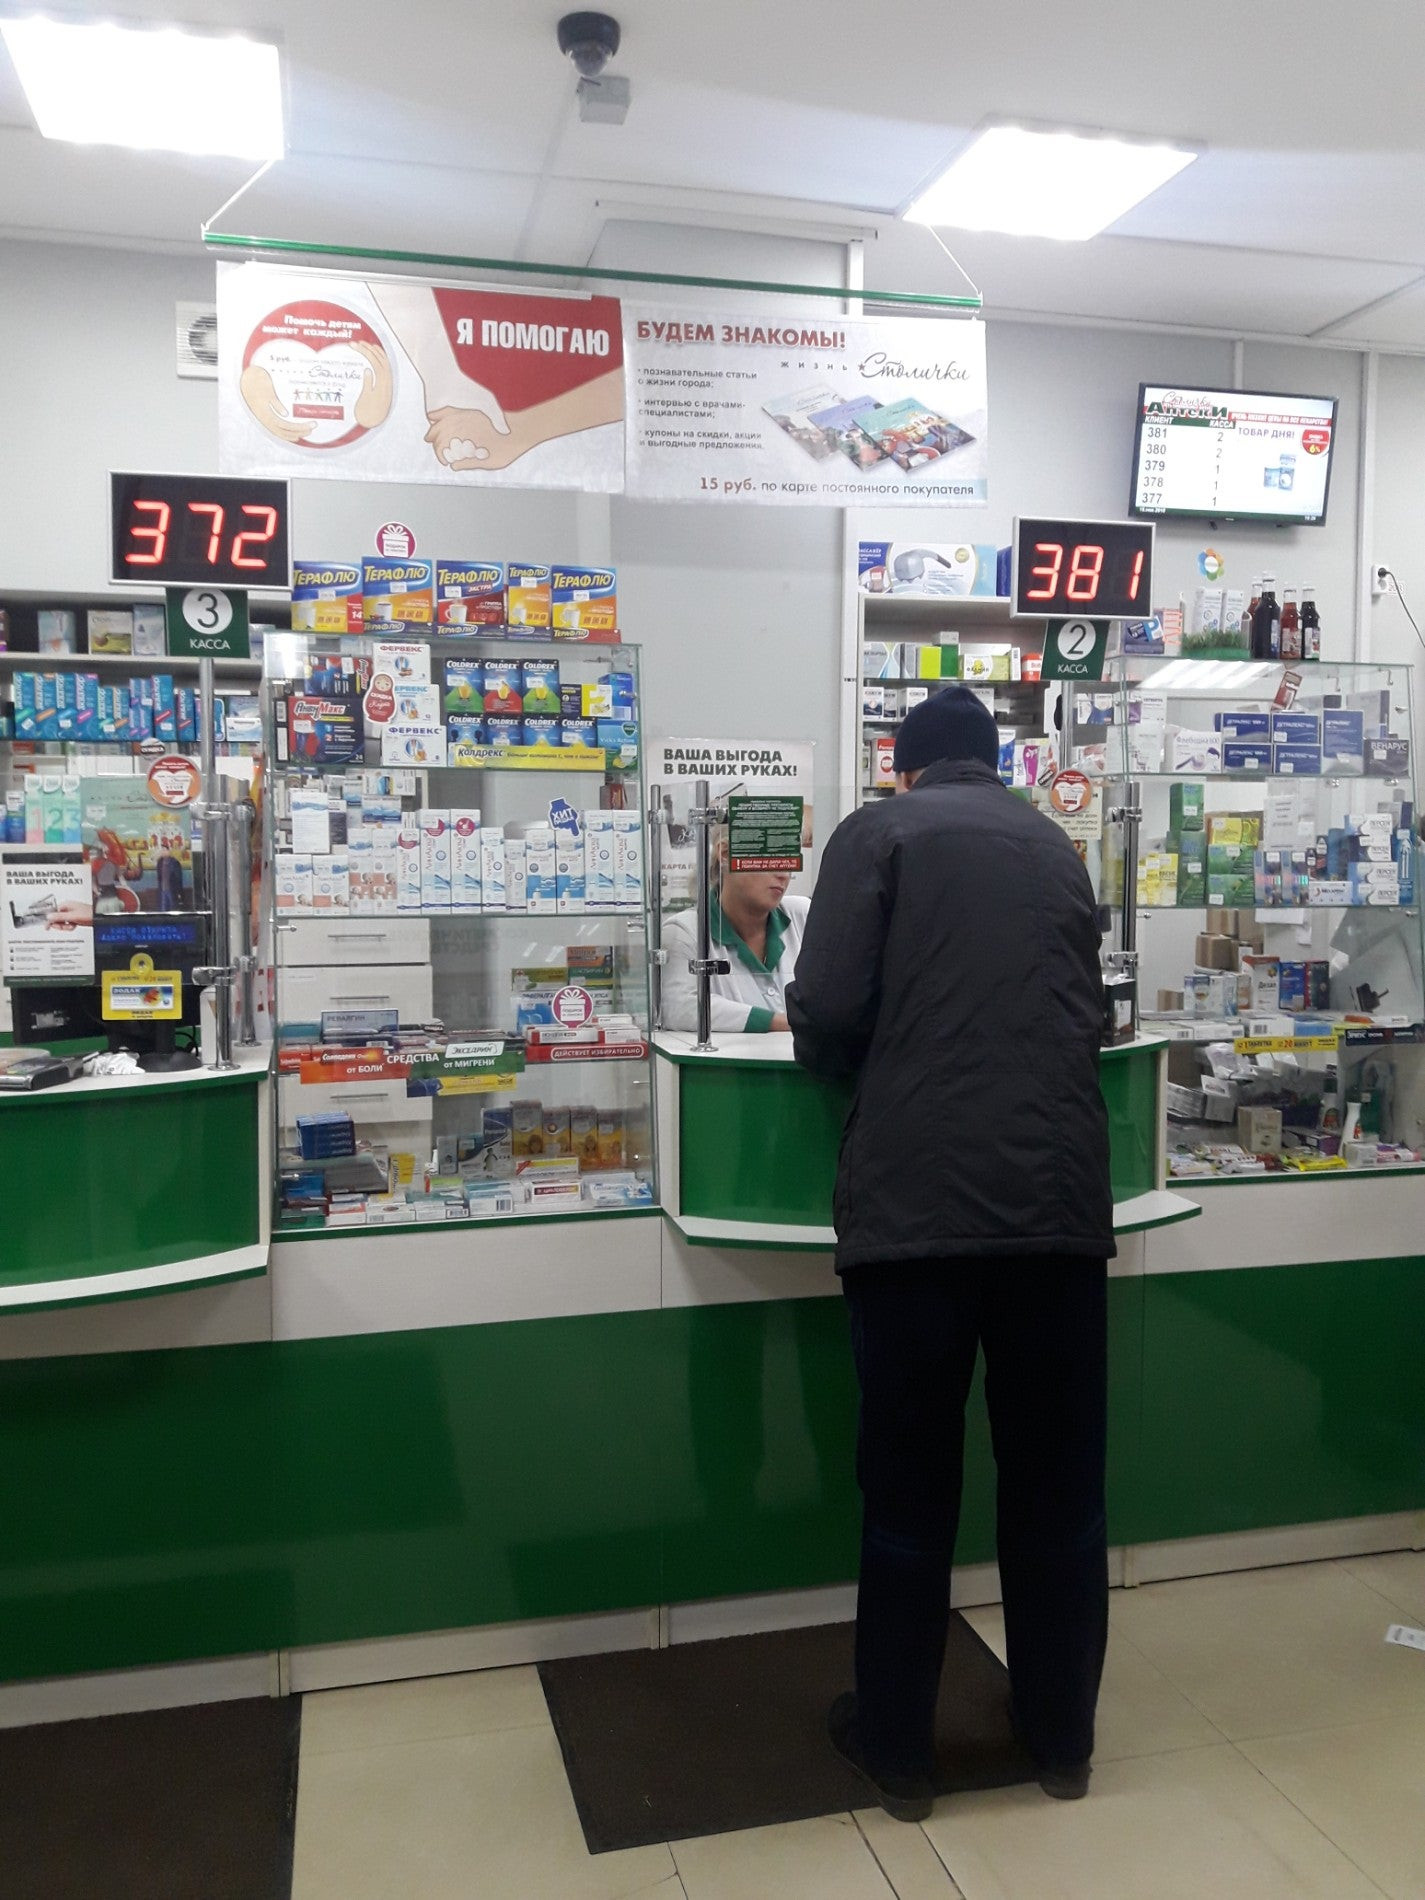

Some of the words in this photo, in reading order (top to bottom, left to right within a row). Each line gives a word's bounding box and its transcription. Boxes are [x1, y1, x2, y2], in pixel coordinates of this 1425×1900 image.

[457, 318, 474, 344] Я
[482, 319, 610, 357] ПОМОГАЮ
[637, 320, 715, 342] БУДЕМ
[721, 324, 847, 349] ЗНАКОМЫ!
[862, 352, 971, 382] Столички
[643, 367, 724, 380] познавательные
[726, 370, 757, 380] статьи
[646, 378, 675, 388] жизни
[644, 400, 692, 411] интервью
[1145, 416, 1174, 424] КЛИЕНТ
[1209, 420, 1234, 428] КАССА
[645, 431, 681, 441] купоны
[733, 432, 761, 442] акции
[1148, 427, 1167, 438] 381
[1217, 432, 1223, 442] 2
[1239, 427, 1269, 437] ТОВАР
[1271, 429, 1295, 439] ДНЯ!
[1147, 444, 1166, 454] 380
[1216, 448, 1222, 458] 2
[1145, 460, 1165, 471] 379
[1216, 465, 1219, 474] 1
[700, 477, 718, 490] 15
[724, 478, 757, 495] руб.
[761, 483, 777, 492] по
[781, 483, 817, 496] карте
[822, 484, 899, 496] постоянного
[903, 484, 974, 498] покупателя
[1143, 477, 1164, 488] 378
[1214, 481, 1218, 490] 1
[1142, 493, 1162, 504] 377
[1212, 497, 1217, 506] 1
[124, 500, 278, 569] 372
[364, 566, 427, 582] ТЕРАФЛЮ
[438, 569, 498, 586] ТЕРАФЛЮ
[509, 567, 547, 578] ТЕРАФЛЮ
[1026, 542, 1145, 601] 381
[294, 570, 356, 586] ТЕРАФЛЮ
[553, 573, 611, 589] ТЕРАФЛЮ
[468, 584, 492, 592] ЭКСТРА
[197, 592, 219, 629] 3
[352, 611, 363, 619] 14
[437, 626, 476, 636] ТЕРАФЛЮ
[554, 629, 587, 638] ТЕРАФЛЮ
[189, 638, 231, 650] КАССА
[1067, 624, 1084, 655] 2
[447, 660, 479, 669] COLDREX
[485, 662, 517, 670] COLDREX
[524, 662, 555, 670] COLDREX
[1057, 663, 1089, 674] КАССА
[449, 715, 482, 724] COLDREX
[488, 717, 519, 726] COLDREX
[525, 718, 557, 726] COLDREX
[562, 718, 593, 726] COLDREX
[388, 727, 442, 735] ФЕРВЕКС
[1371, 741, 1407, 750] ВЕНАРУС
[458, 748, 503, 758] Колдрекс
[664, 749, 712, 761] ВАША
[716, 750, 782, 763] ВЫГОДА
[664, 764, 673, 774] В
[678, 764, 737, 775] ВАШИХ
[741, 765, 797, 776] РУКАХ!
[32, 809, 42, 825] 1
[48, 808, 64, 825] 2
[66, 808, 80, 824] 3
[552, 809, 574, 820] ХИТ
[591, 1048, 640, 1056] ИЗБИРАТЕЛЬНО
[387, 1053, 439, 1064] СРЕДСТВА
[455, 1060, 495, 1068] МИГРЕНИ
[358, 1065, 383, 1075] БОЛИ
